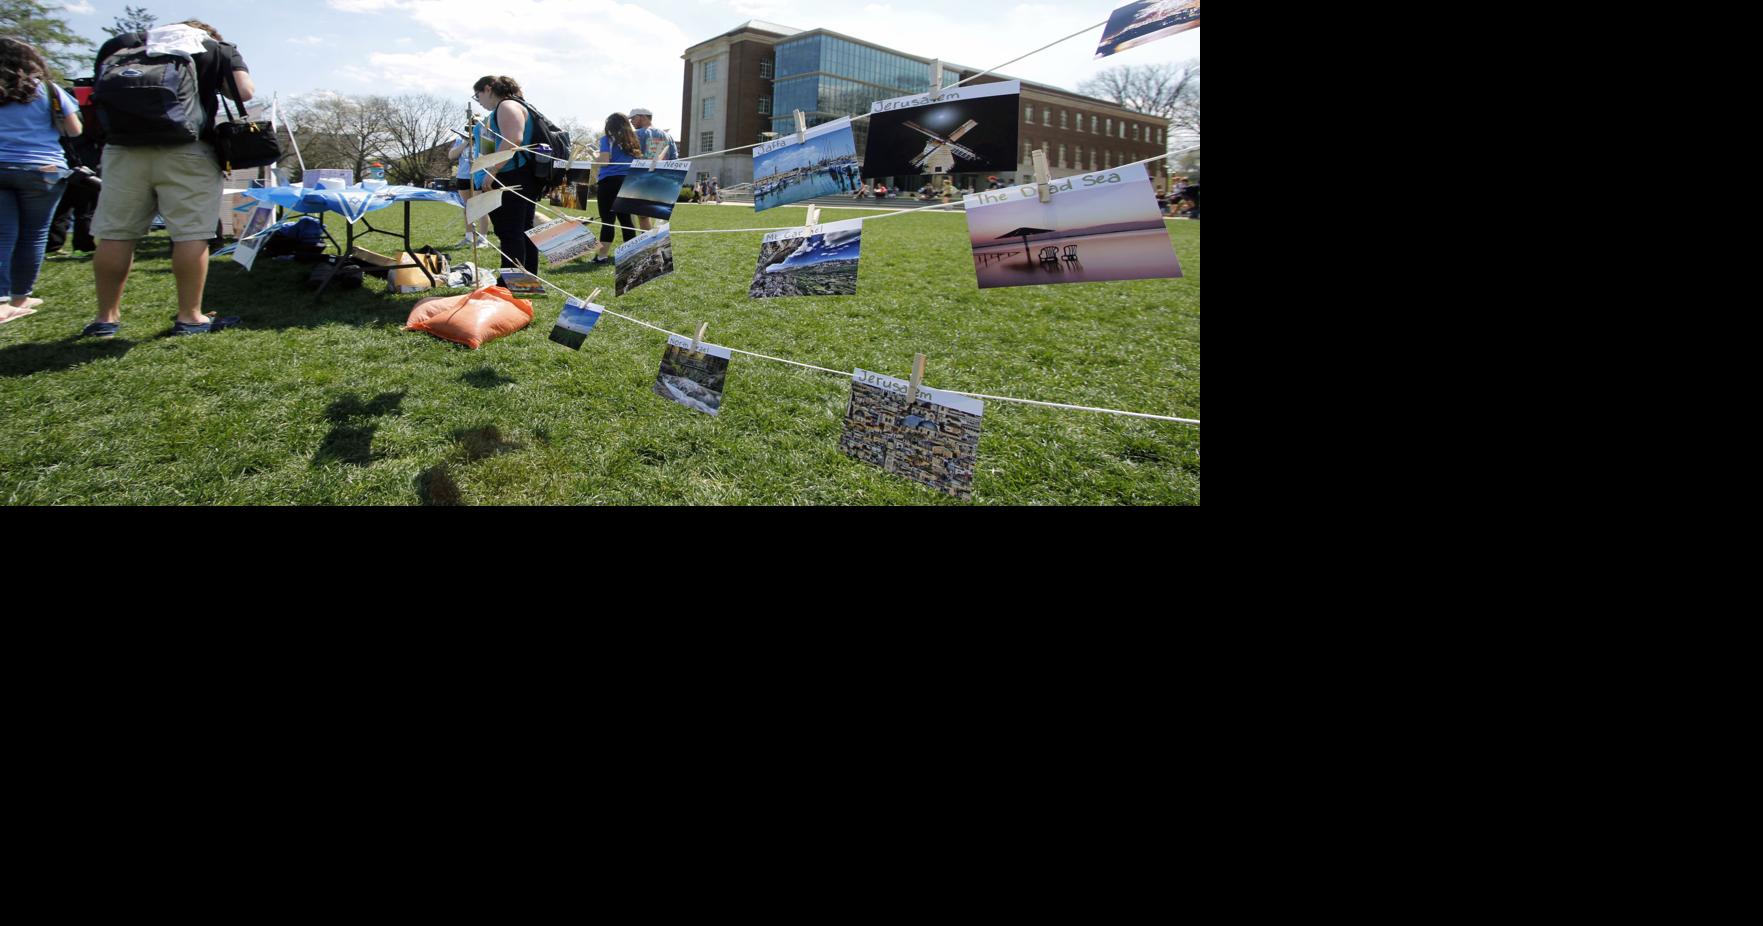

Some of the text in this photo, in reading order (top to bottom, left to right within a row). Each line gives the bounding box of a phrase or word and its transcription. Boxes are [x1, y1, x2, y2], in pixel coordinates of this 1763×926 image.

[874, 92, 960, 113] Jerusaem
[757, 140, 786, 155] Jaffa
[975, 171, 1121, 205] The Dad Sea
[858, 370, 932, 400] Jerusaem
